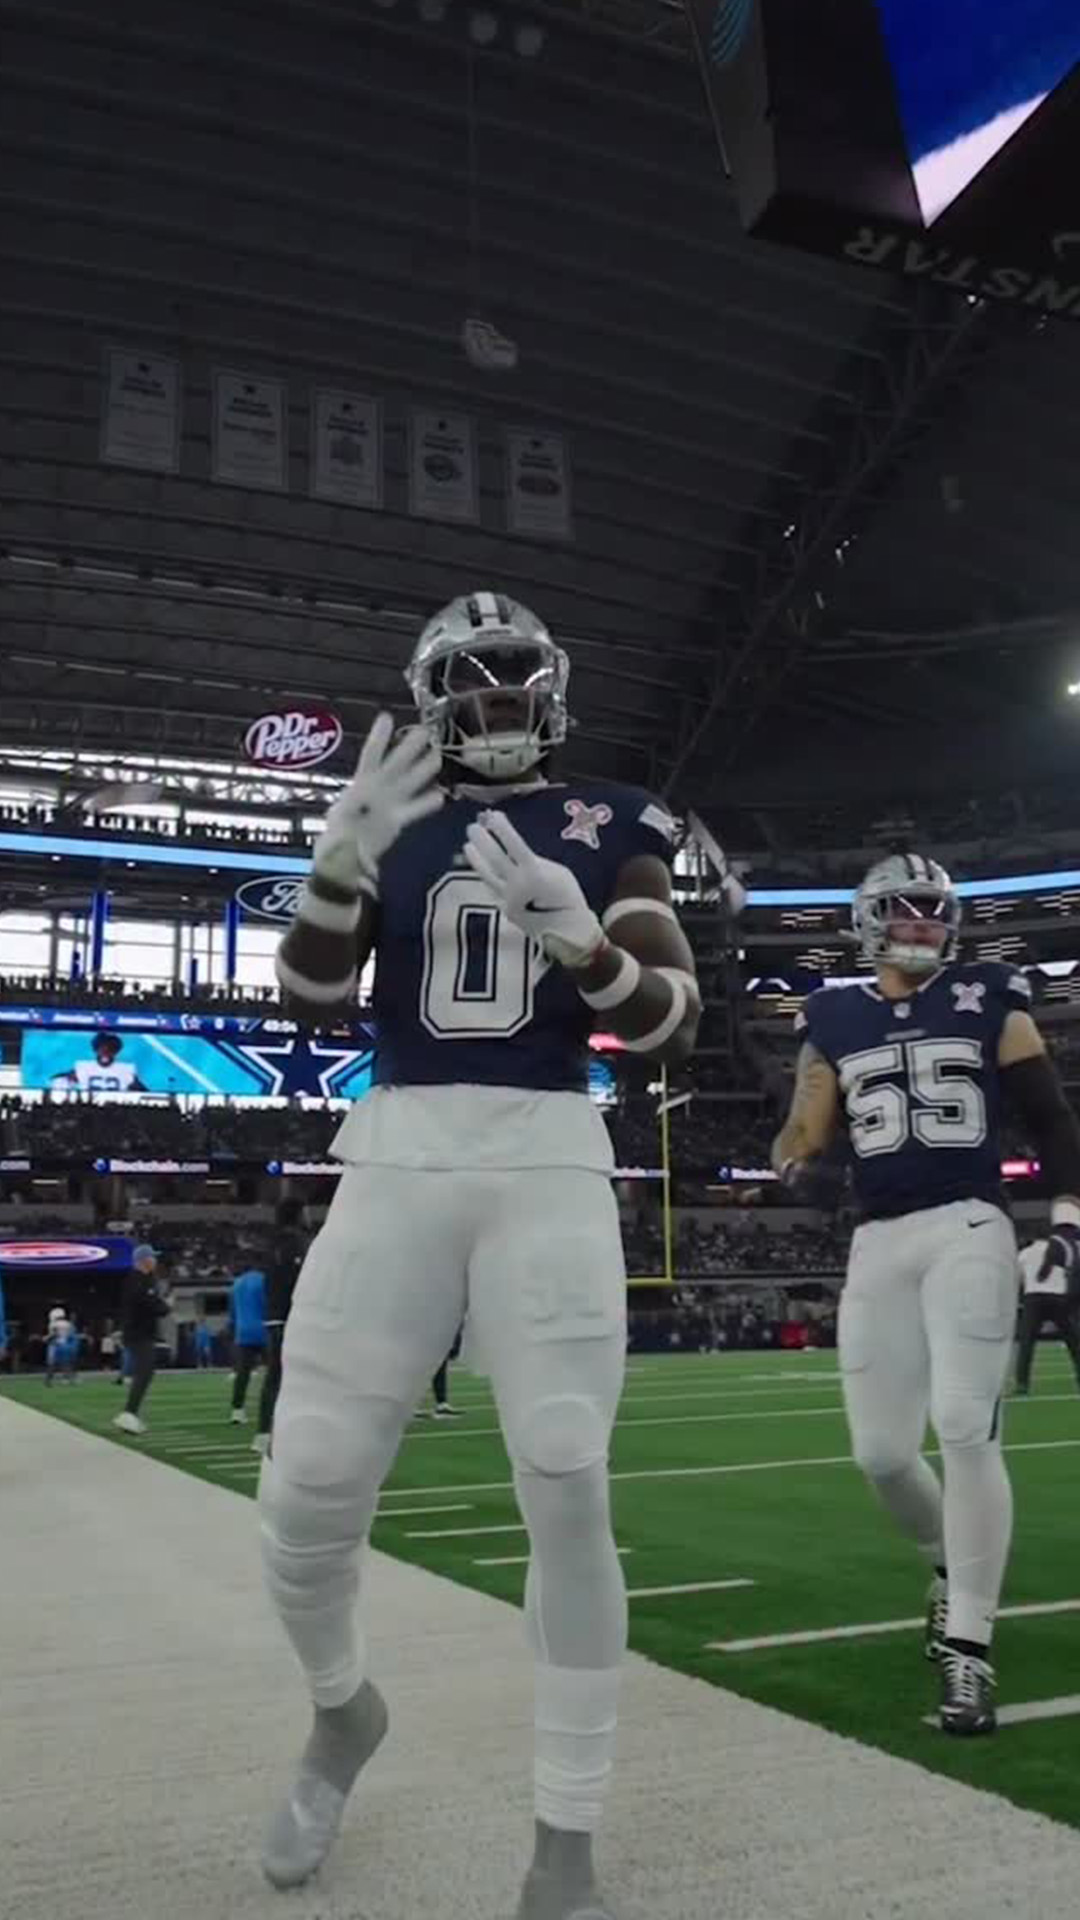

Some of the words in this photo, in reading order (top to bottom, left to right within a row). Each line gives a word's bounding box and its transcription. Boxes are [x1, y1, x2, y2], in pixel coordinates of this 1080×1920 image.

[843, 227, 1080, 316] NSTAR
[253, 714, 336, 763] Pepper
[283, 712, 318, 737] Dr
[420, 870, 536, 1040] 0
[837, 1037, 987, 1159] 55
